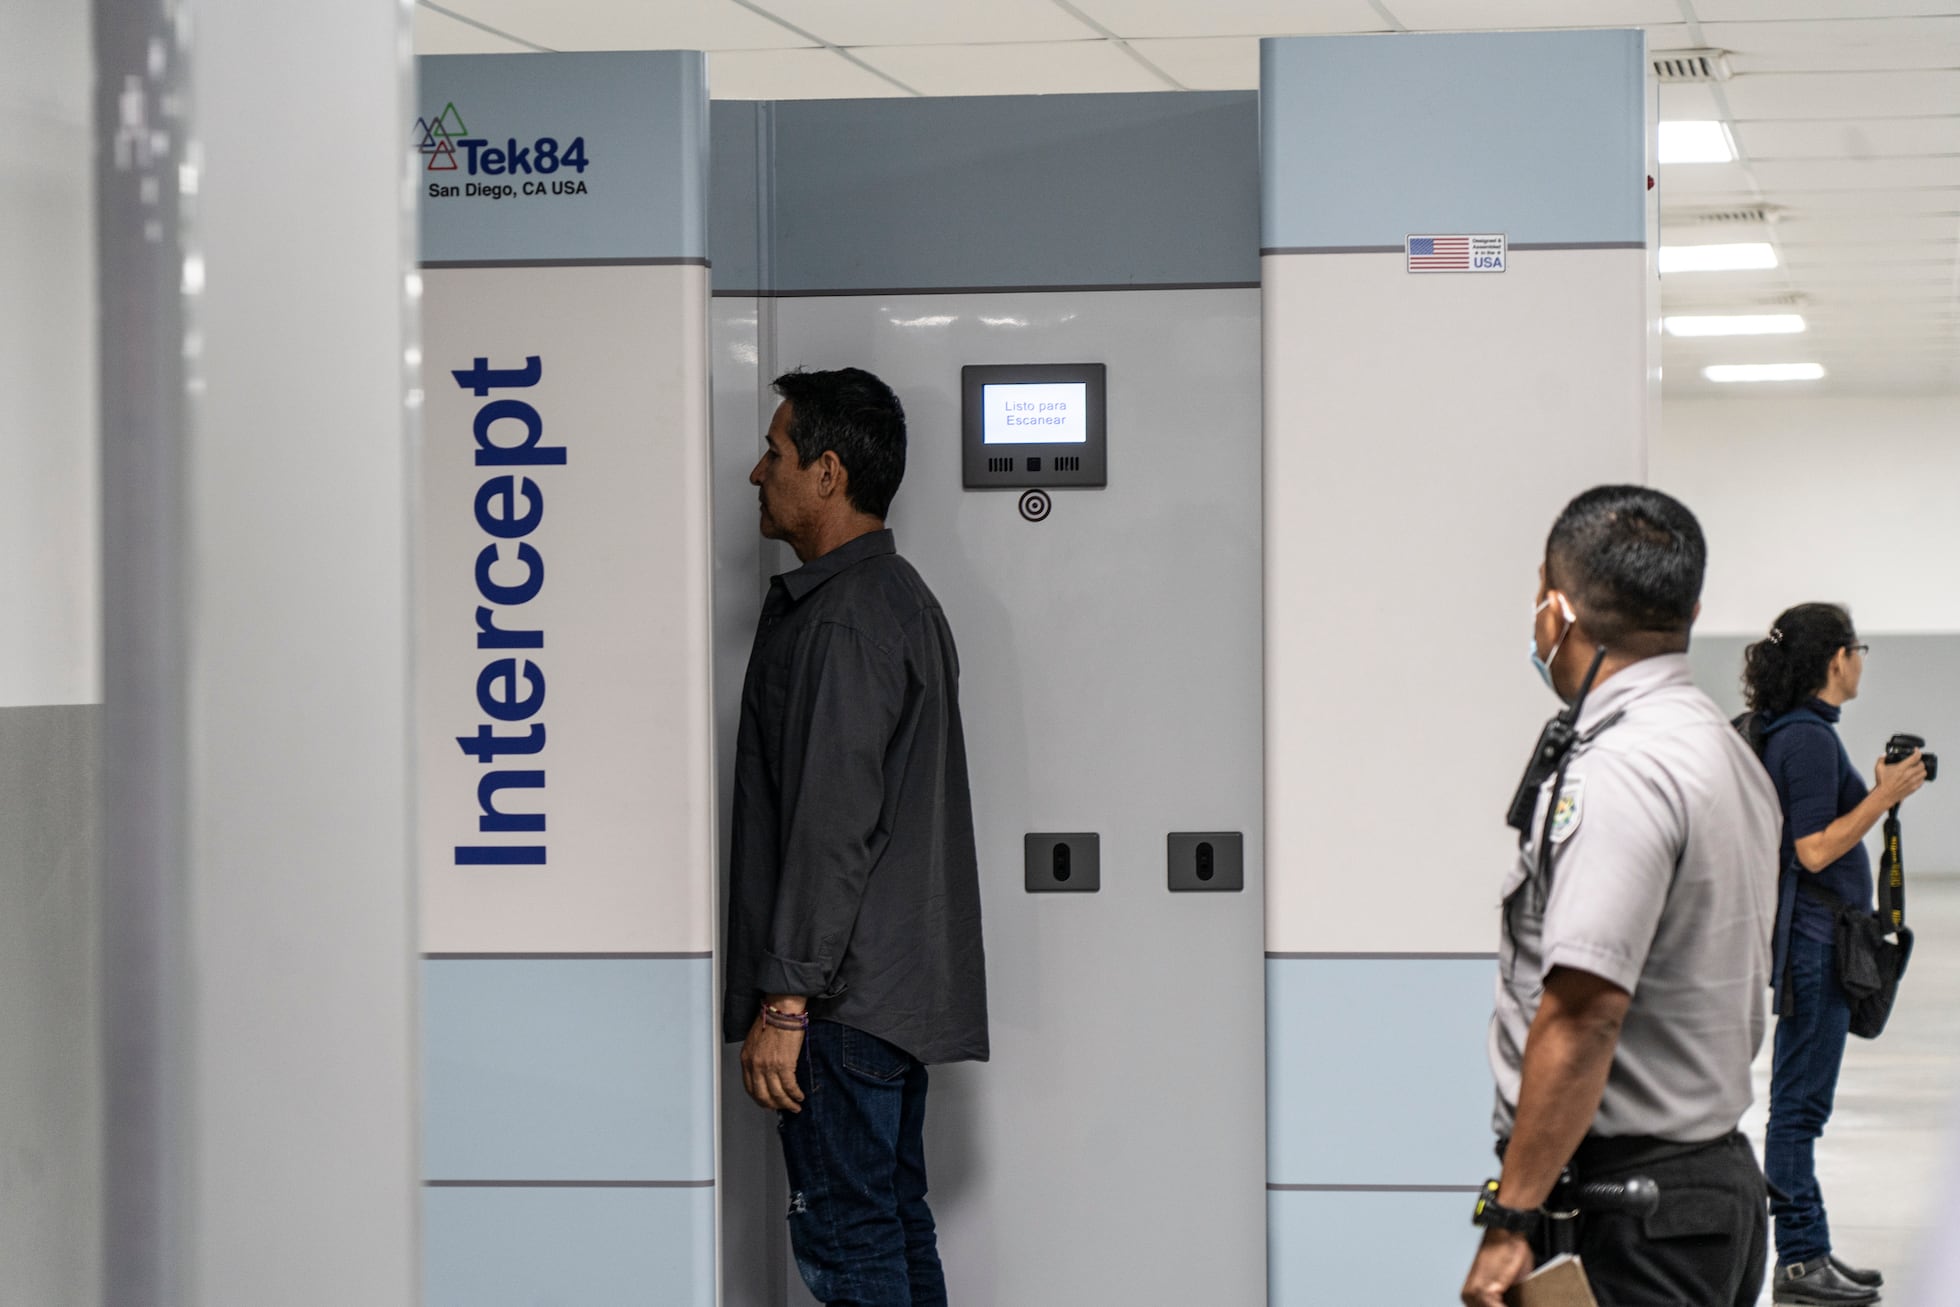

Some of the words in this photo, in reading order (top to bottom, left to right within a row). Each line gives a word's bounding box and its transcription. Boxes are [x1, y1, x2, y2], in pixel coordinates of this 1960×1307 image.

[457, 137, 589, 175] Tek84
[428, 183, 460, 198] San
[465, 182, 518, 199] Diego,
[522, 181, 547, 196] CA
[552, 180, 588, 196] USA
[1474, 256, 1503, 269] USA
[1005, 400, 1035, 412] Listo
[1039, 401, 1067, 413] para
[1006, 414, 1067, 426] Escanear
[451, 355, 567, 865] Intercept
